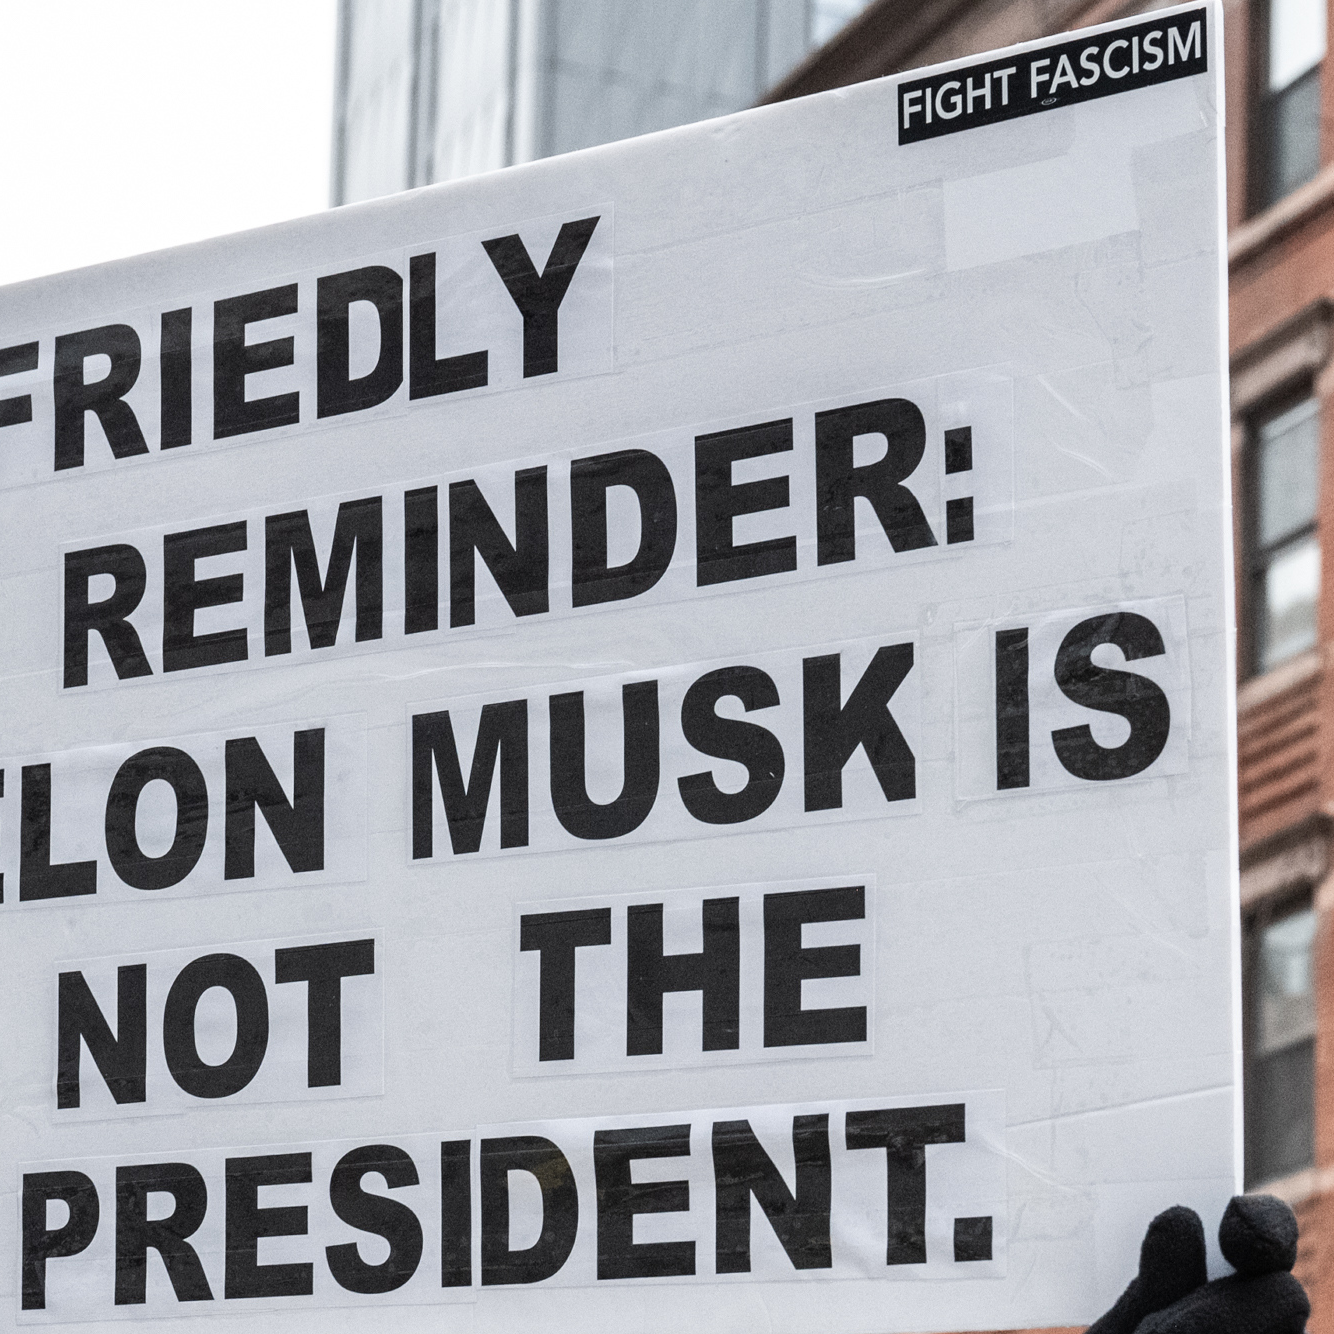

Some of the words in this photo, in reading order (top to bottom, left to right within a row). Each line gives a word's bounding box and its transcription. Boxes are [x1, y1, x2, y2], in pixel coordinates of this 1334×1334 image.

[903, 66, 1017, 129] FIGHT
[1030, 20, 1202, 98] FASCISM
[63, 397, 975, 689] REMINDER:
[411, 641, 917, 860] MUSK
[995, 611, 1171, 791] IS
[56, 938, 375, 1110] NOT
[519, 885, 868, 1062] THE
[21, 1103, 993, 1311] PRESIDENT.
